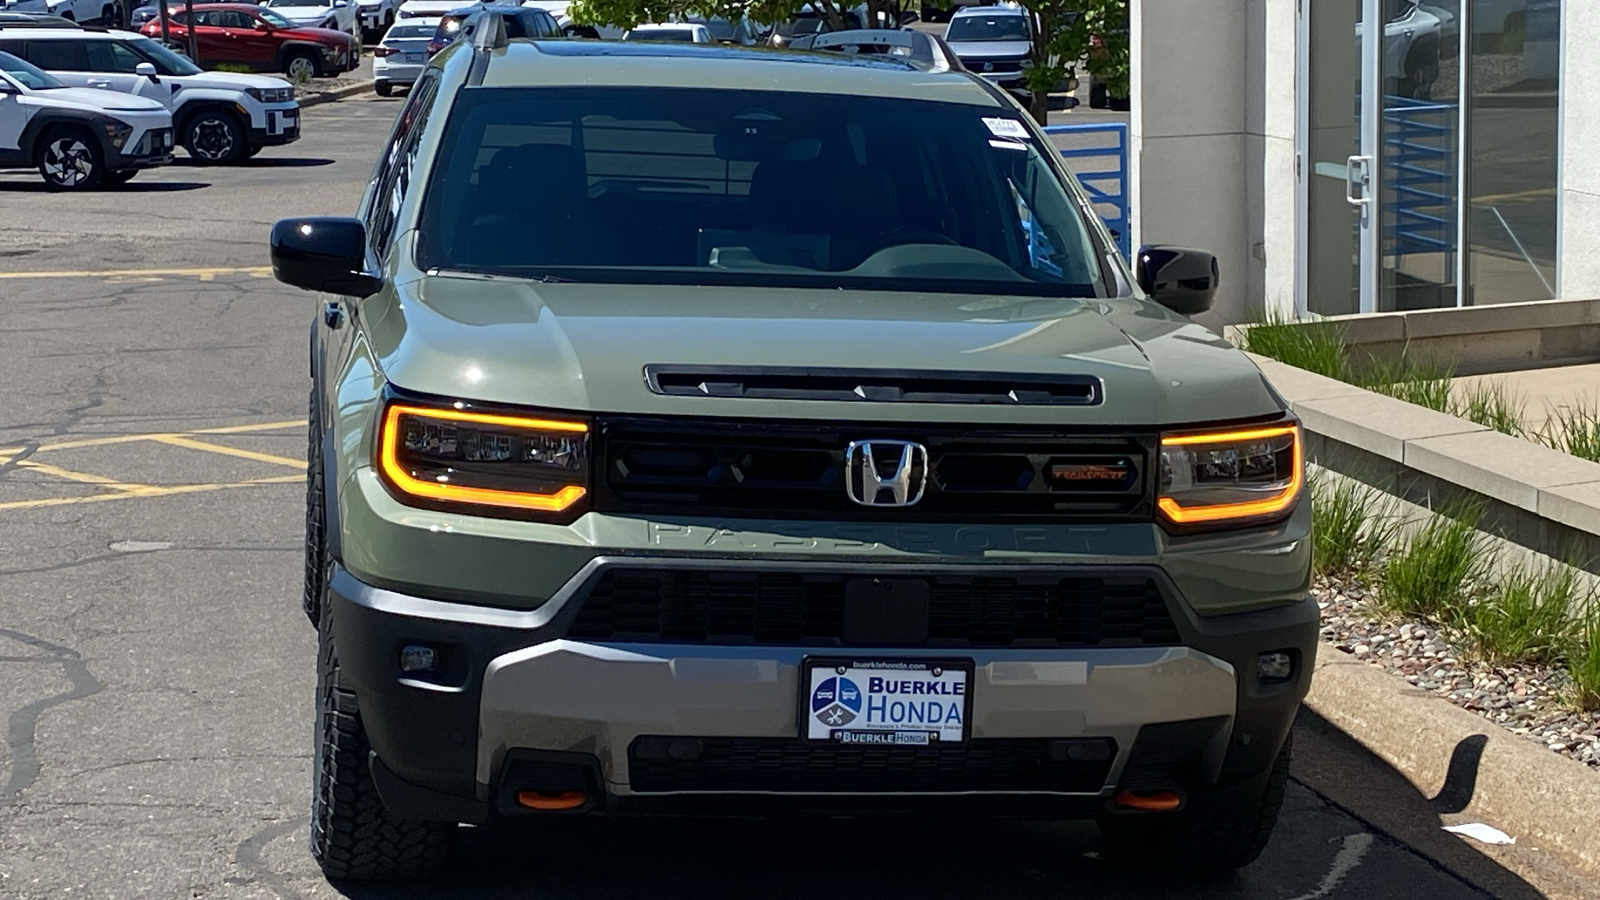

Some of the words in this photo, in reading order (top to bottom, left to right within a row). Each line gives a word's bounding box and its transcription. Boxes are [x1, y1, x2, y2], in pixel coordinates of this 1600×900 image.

[853, 661, 927, 670] buerklehonda.com
[868, 677, 965, 695] BUERKLE
[866, 695, 962, 724] HONDA
[842, 732, 895, 743] BUERKLE
[896, 732, 927, 744] HONDA
